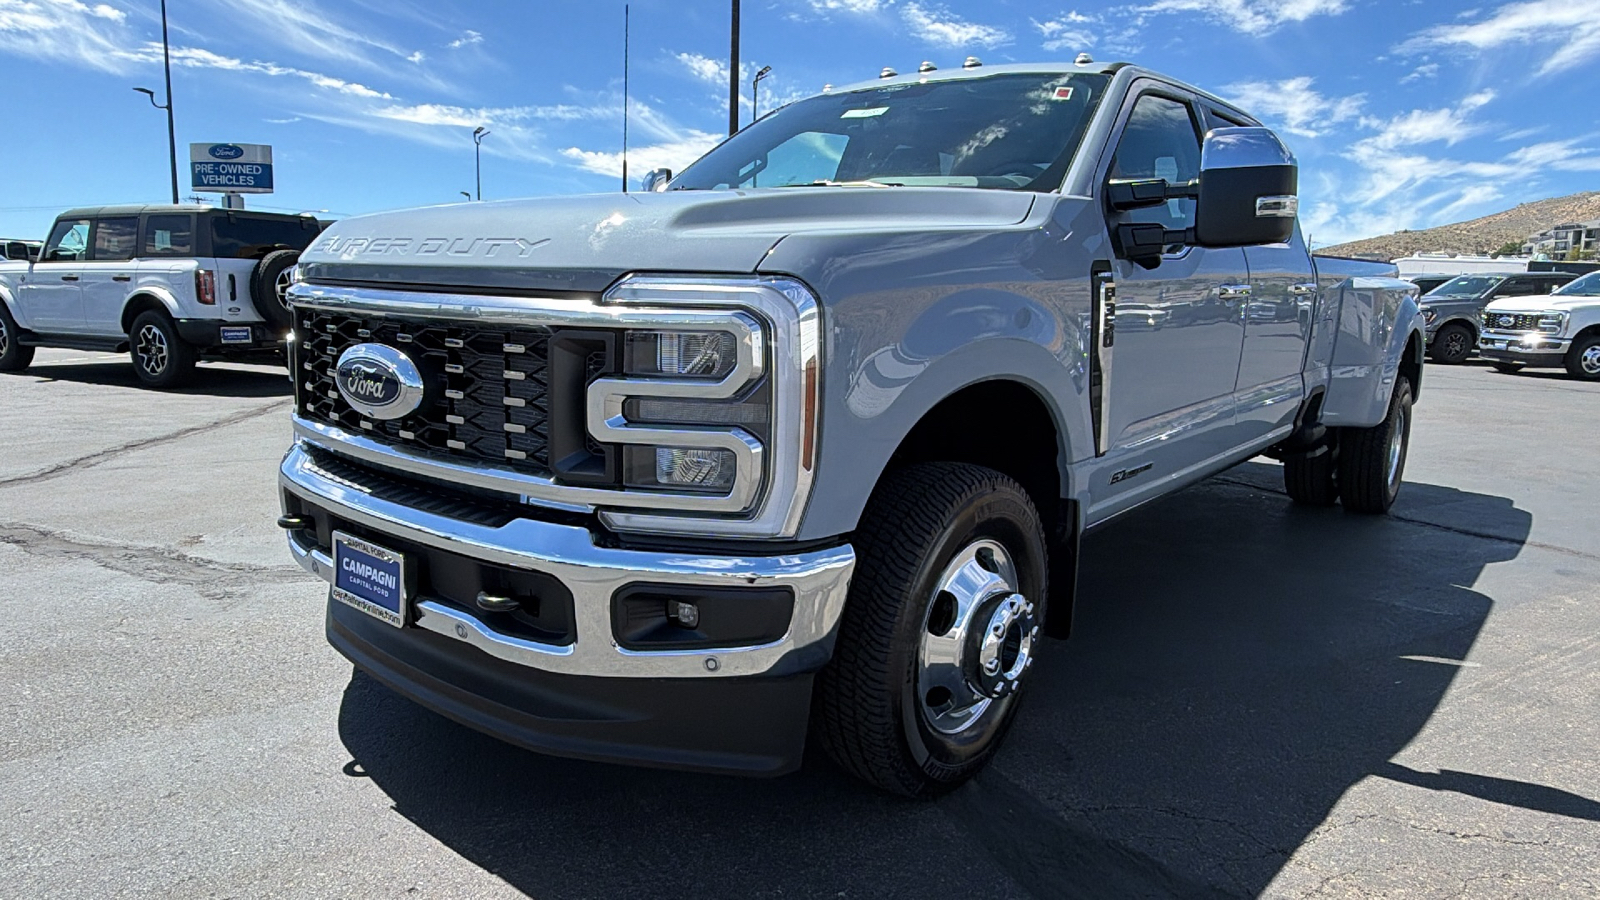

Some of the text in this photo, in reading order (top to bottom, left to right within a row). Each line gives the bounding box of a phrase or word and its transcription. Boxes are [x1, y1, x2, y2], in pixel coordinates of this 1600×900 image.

[215, 147, 235, 156] Ford
[195, 164, 262, 175] PRE-OWNED
[202, 175, 254, 186] VEHICLES
[313, 237, 551, 258] SUPER DUTY
[347, 364, 386, 398] Ford
[370, 547, 387, 559] FORD
[342, 557, 396, 590] CAMPAGNI
[349, 576, 389, 598] CAPITAL FORD
